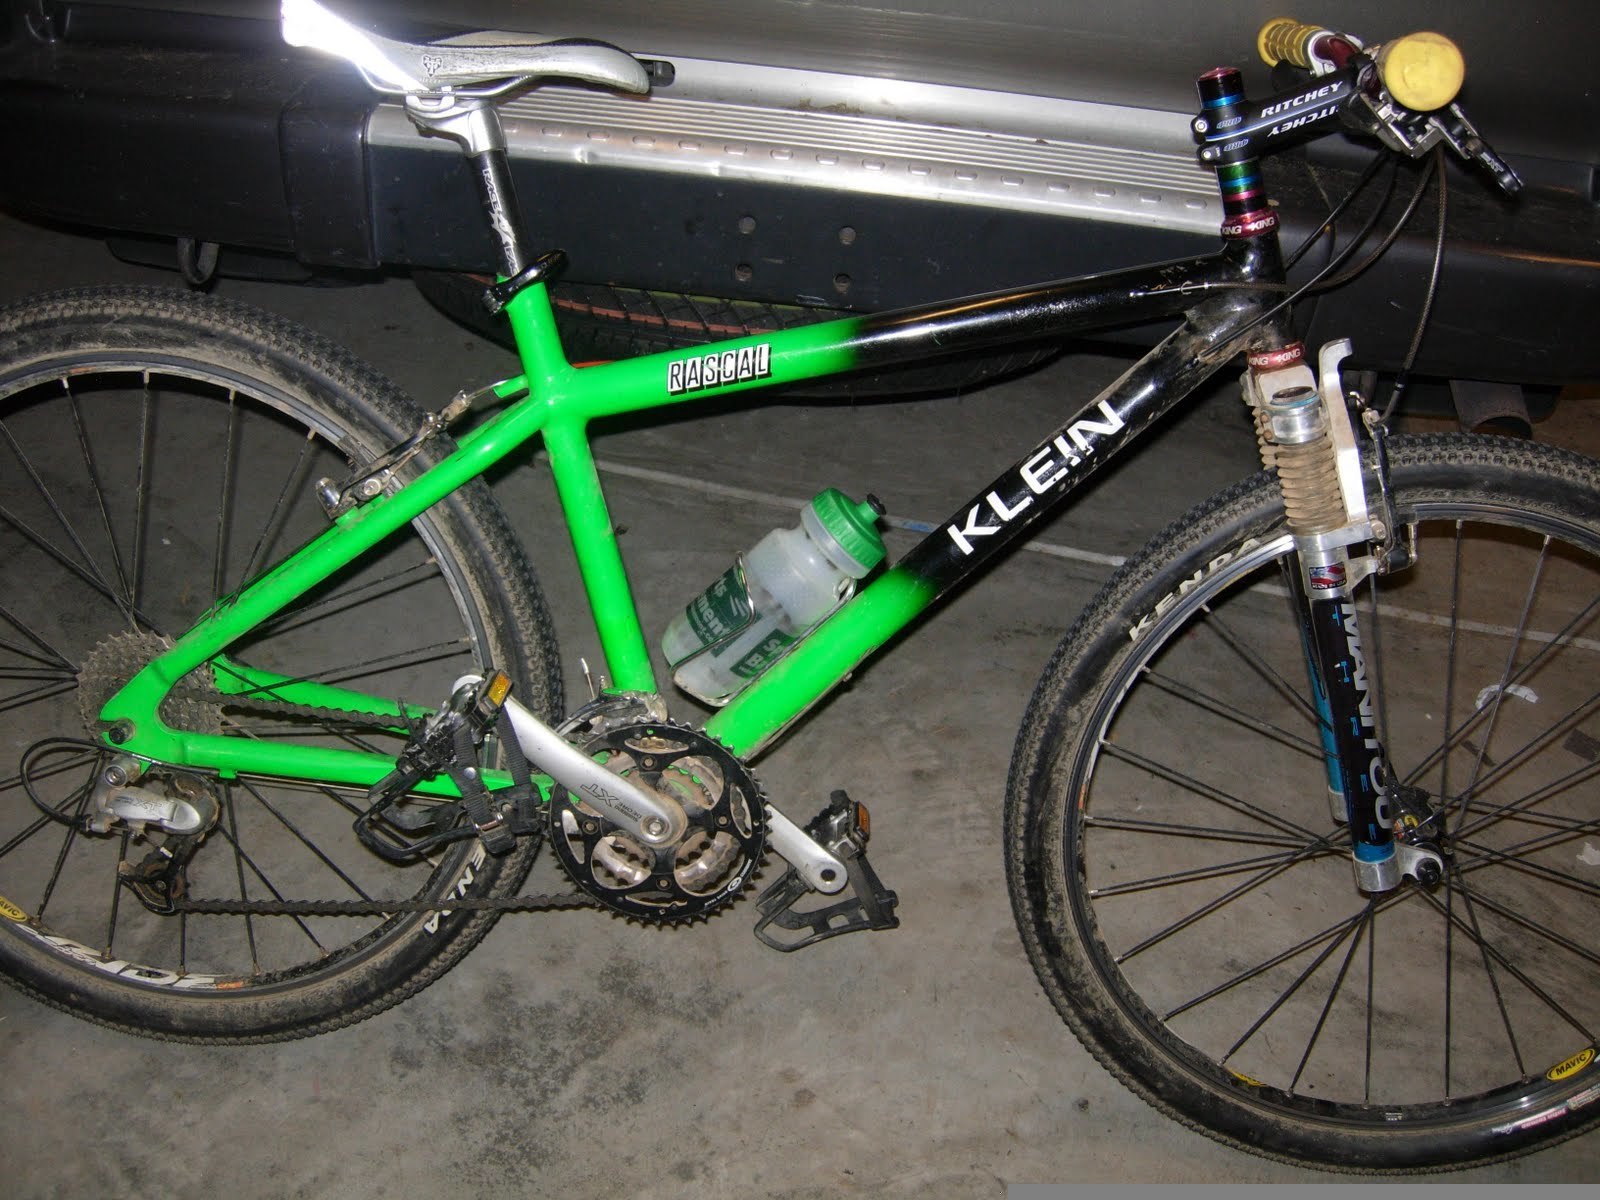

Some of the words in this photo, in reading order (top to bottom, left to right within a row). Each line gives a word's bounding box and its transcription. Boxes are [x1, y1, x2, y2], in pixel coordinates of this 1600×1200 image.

[1260, 81, 1343, 118] RITCHEY
[1266, 104, 1340, 138] ITCHEY
[482, 168, 502, 213] RACE
[1251, 217, 1275, 231] KING
[667, 343, 772, 396] RASCAL
[1249, 356, 1269, 366] KING
[1280, 348, 1301, 362] KING
[946, 399, 1125, 556] KLEIN
[579, 783, 620, 807] XT
[423, 843, 487, 935] ENA
[0, 900, 20, 917] AVIC
[1555, 1053, 1587, 1076] MAVIC
